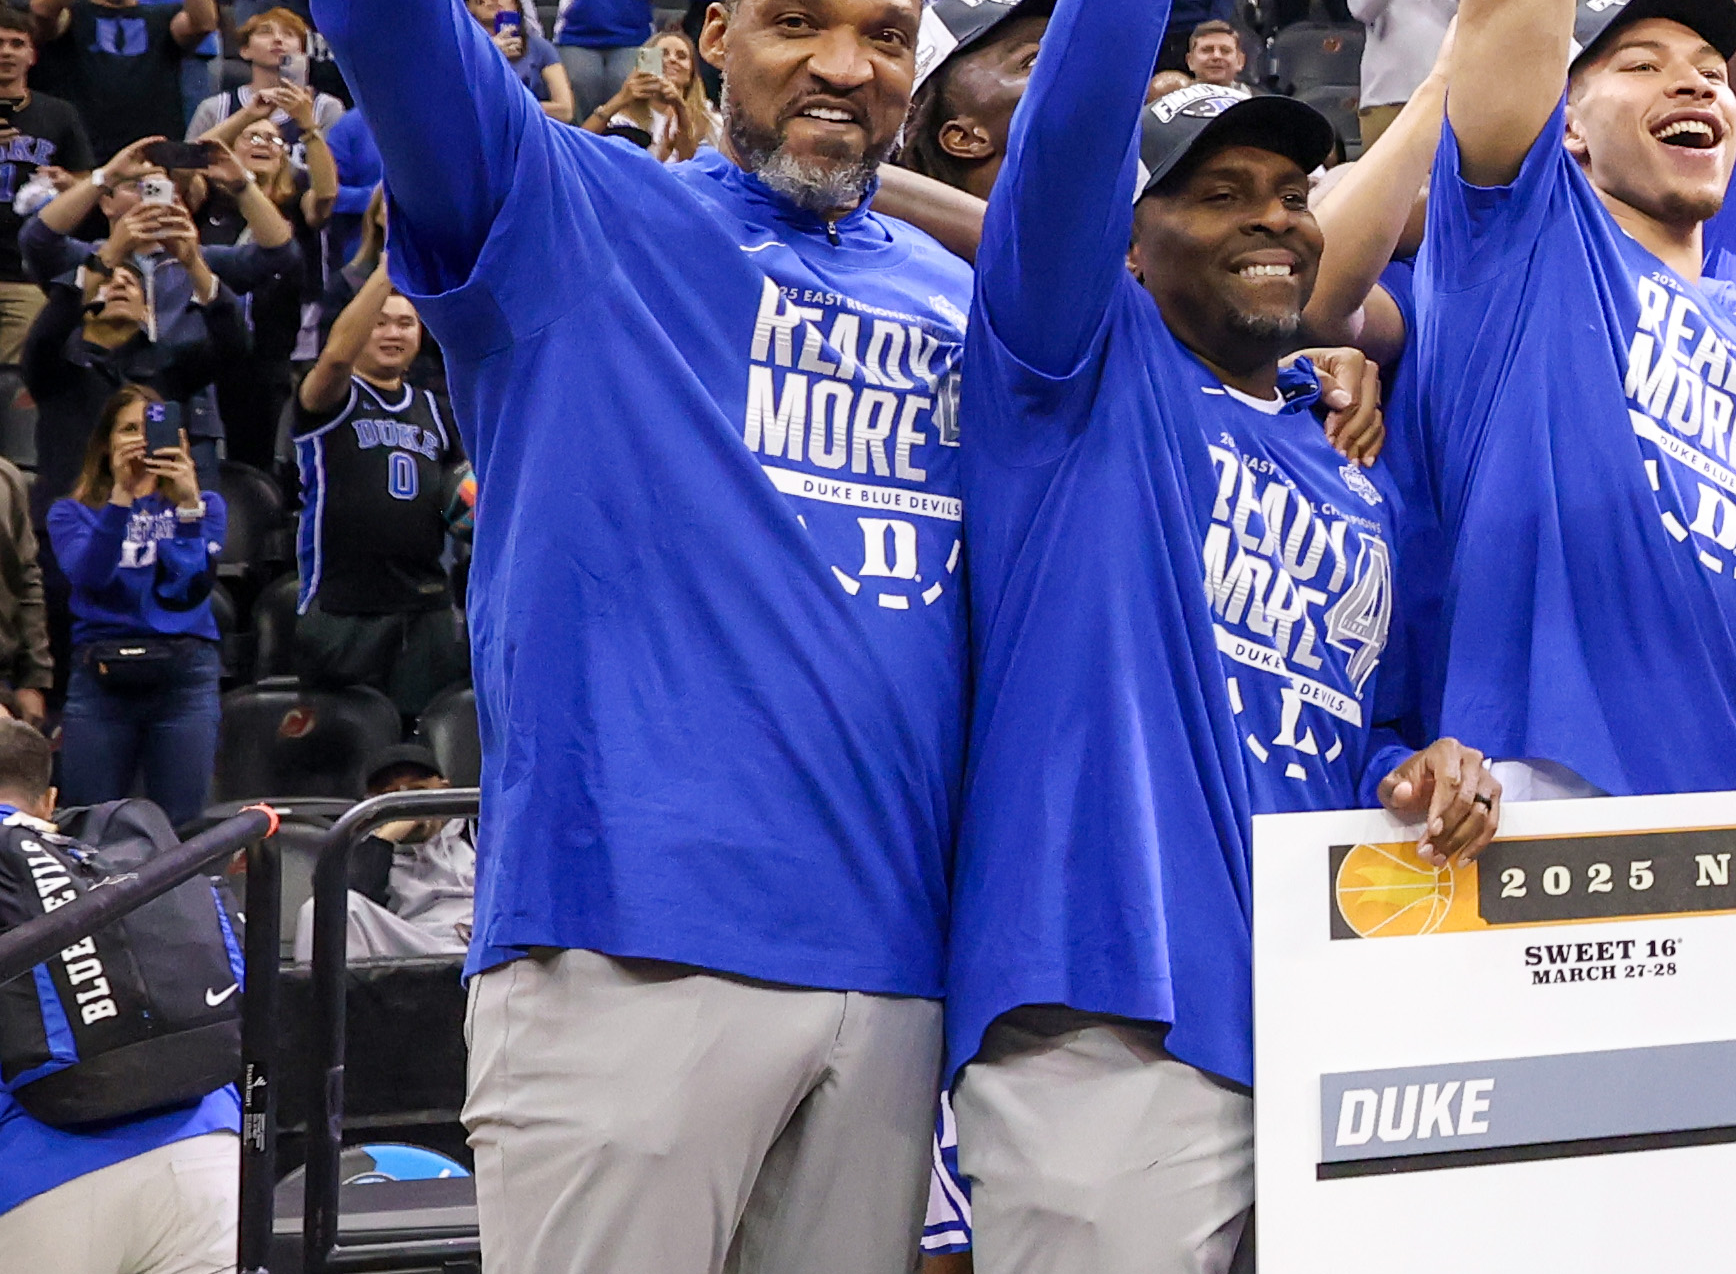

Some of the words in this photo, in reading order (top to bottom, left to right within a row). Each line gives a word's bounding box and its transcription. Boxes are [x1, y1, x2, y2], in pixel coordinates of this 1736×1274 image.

[803, 289, 843, 307] EAST
[750, 275, 938, 394] READY
[352, 418, 440, 462] DUKE
[744, 365, 931, 482] MORE
[388, 451, 418, 501] 0
[1659, 433, 1698, 464] DUKE
[1703, 462, 1736, 489] BLUE
[803, 480, 852, 500] DUKE
[861, 490, 902, 507] BLUE
[910, 497, 960, 516] DEVILS
[1203, 523, 1328, 671] MORE
[1236, 643, 1281, 670] DUKE
[1300, 683, 1346, 714] DEVILS
[1501, 857, 1656, 900] 2025
[61, 935, 119, 1026] BLUE
[1525, 941, 1638, 967] SWEET
[1530, 965, 1616, 986] MARCH
[1622, 961, 1678, 981] 27-28
[1335, 1078, 1495, 1147] DUKE
